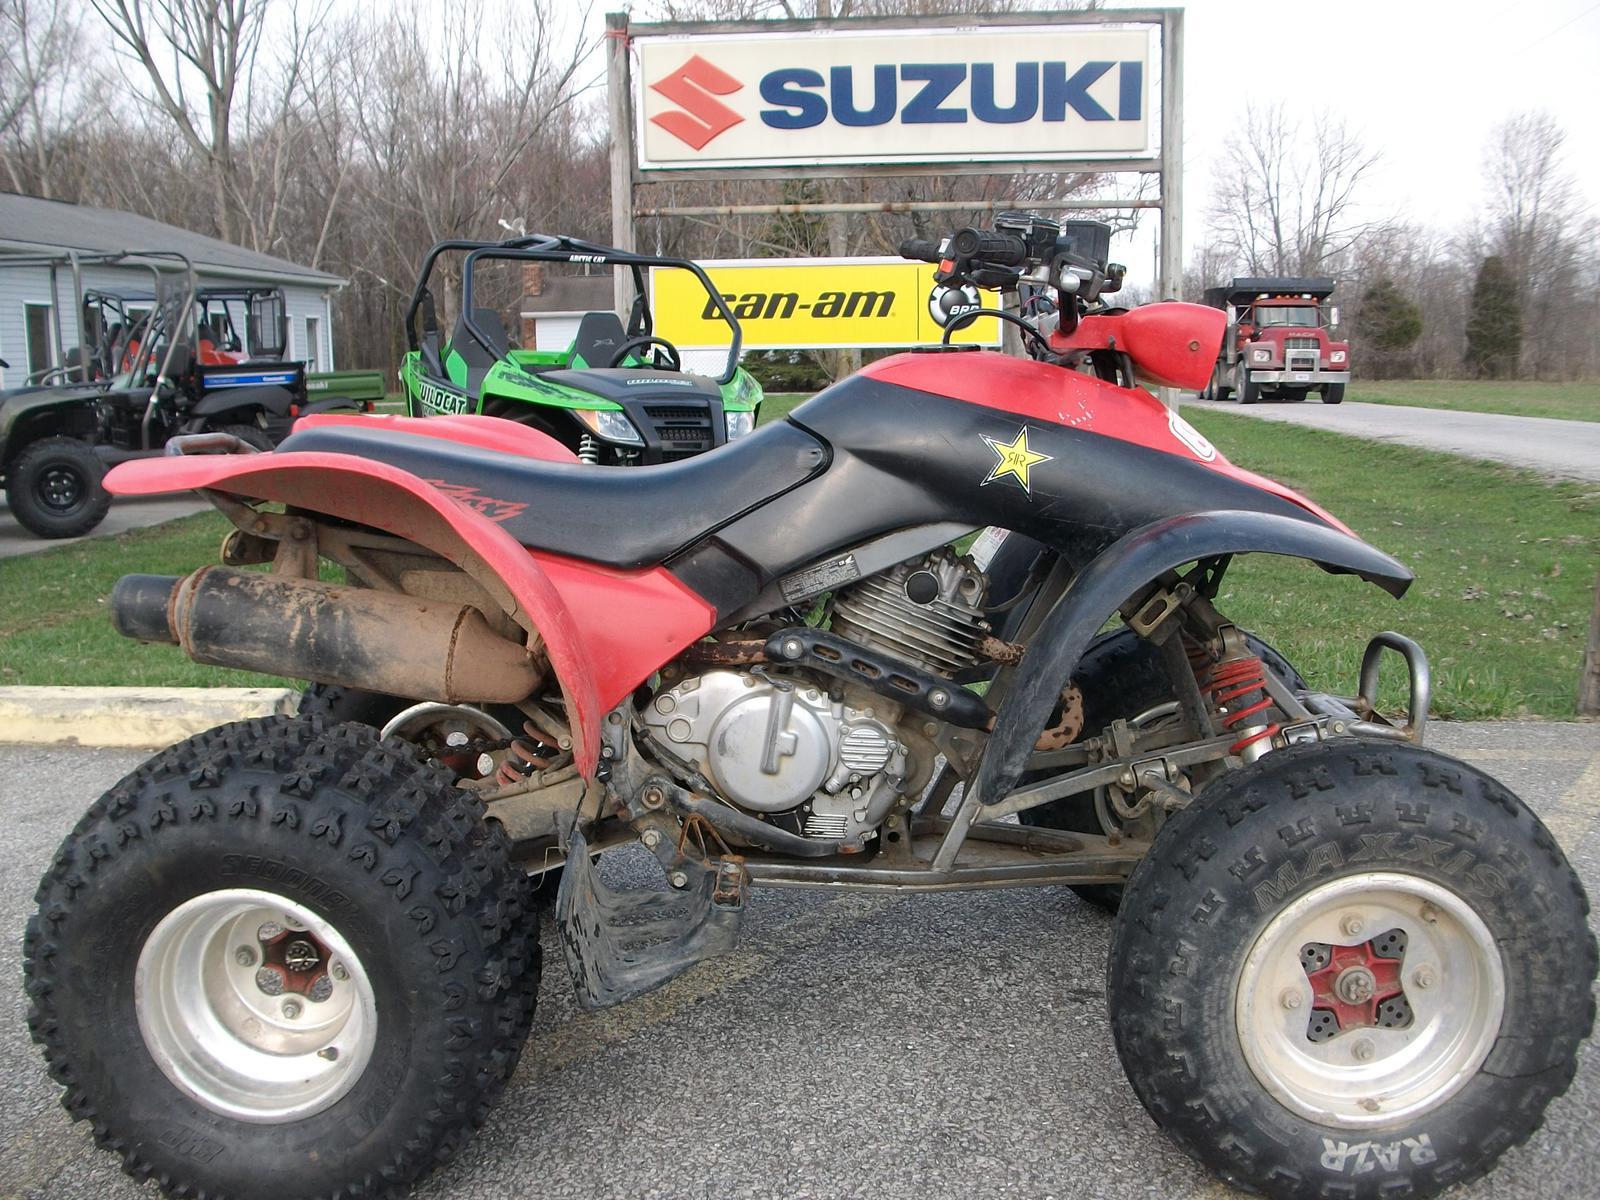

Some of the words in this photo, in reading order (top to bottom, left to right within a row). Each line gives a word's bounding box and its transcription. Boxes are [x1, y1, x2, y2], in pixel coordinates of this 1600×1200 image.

[759, 61, 1142, 130] SUZUKI
[701, 291, 896, 320] can-am
[419, 382, 467, 415] WILDCAT
[221, 852, 353, 913] SEDONA
[1252, 831, 1509, 914] MAXXIS
[1320, 1132, 1439, 1177] RAZR
